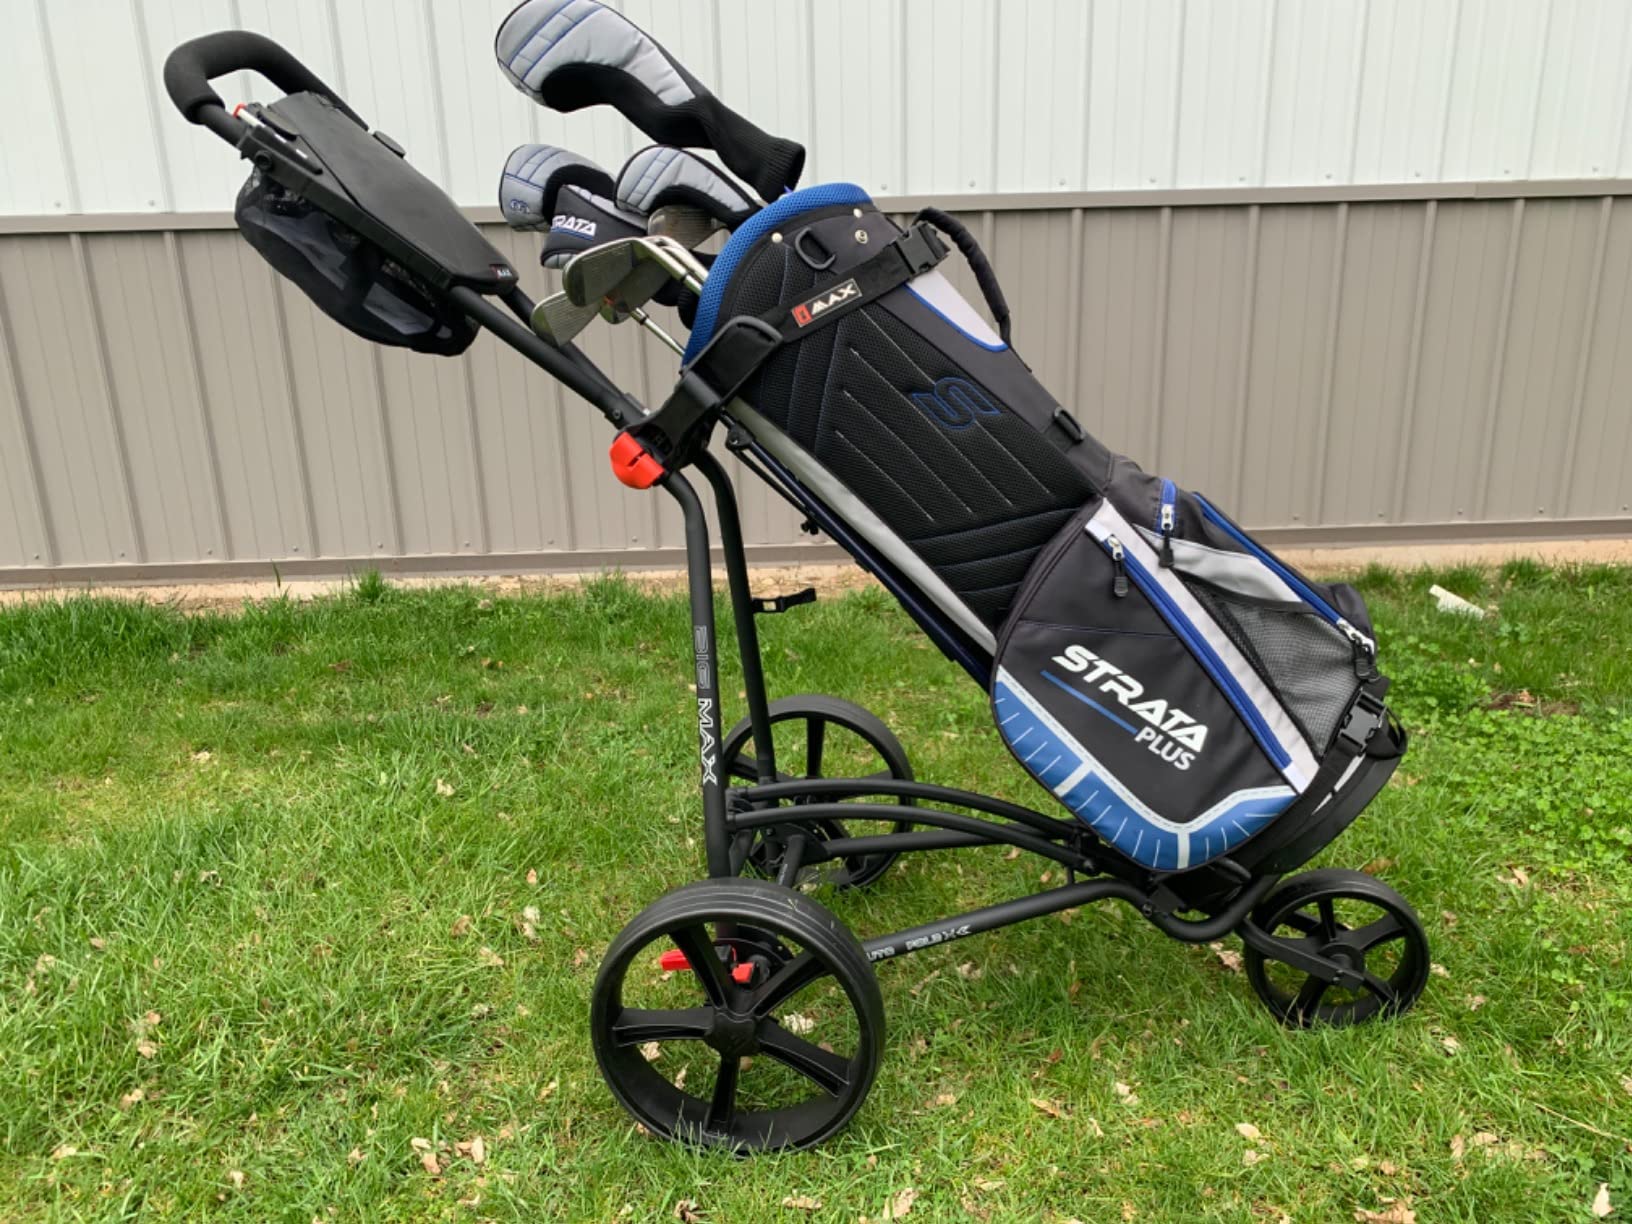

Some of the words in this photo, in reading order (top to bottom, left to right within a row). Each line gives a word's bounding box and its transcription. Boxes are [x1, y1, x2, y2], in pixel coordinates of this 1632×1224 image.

[551, 214, 597, 237] RATA
[811, 283, 857, 315] MAX
[1051, 644, 1208, 752] STRATA
[698, 697, 718, 786] MAX
[1134, 726, 1196, 771] PLUS
